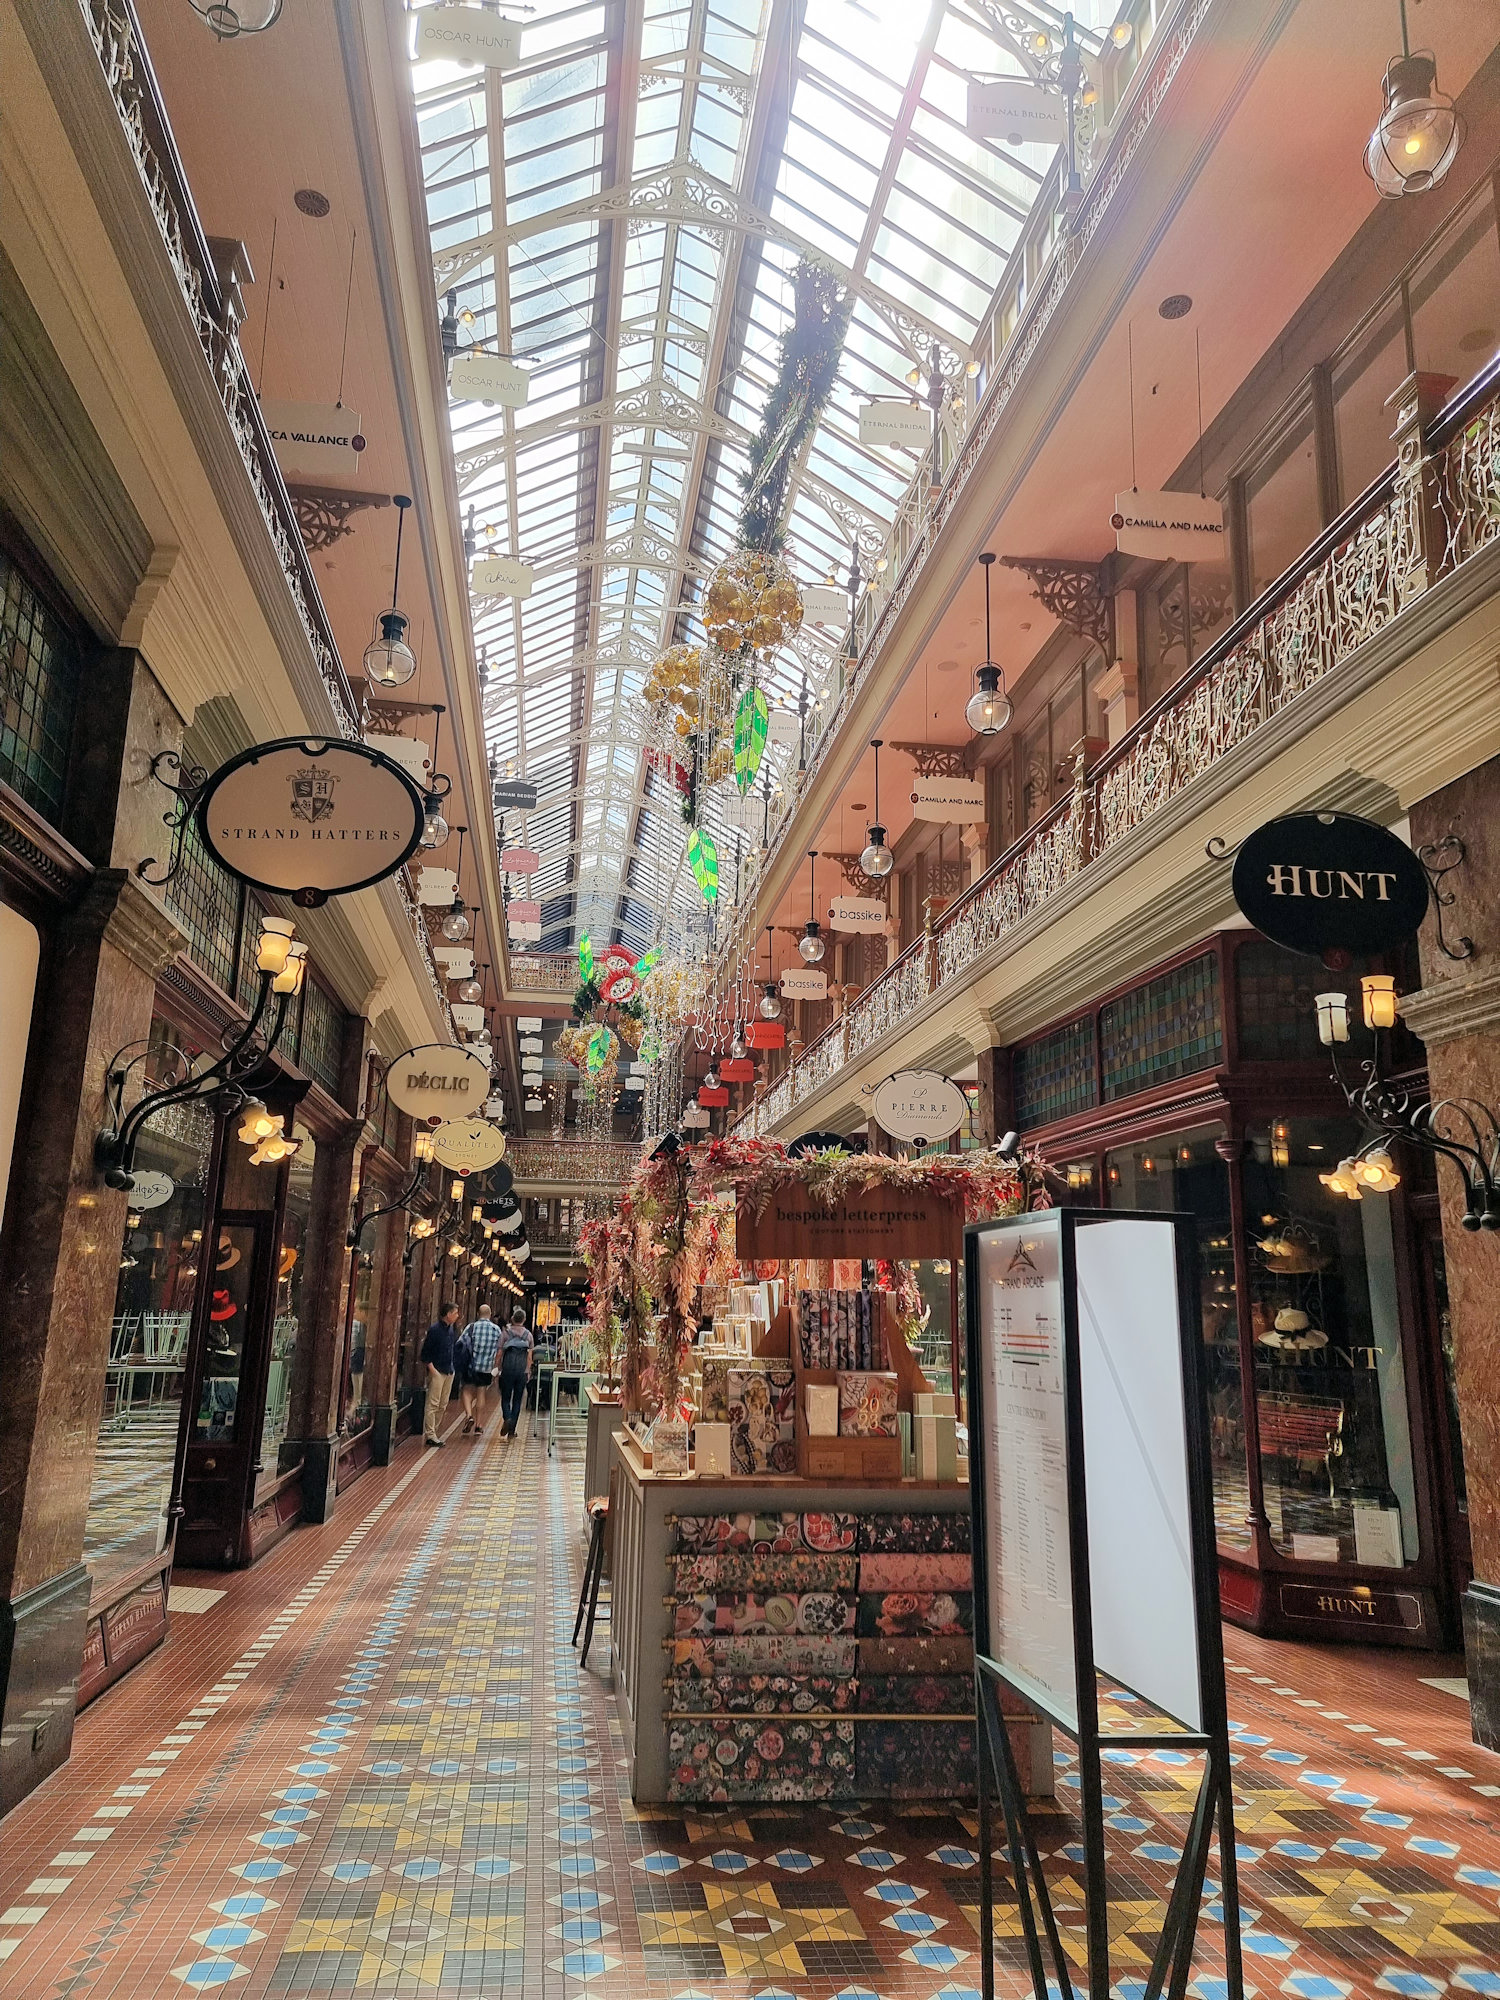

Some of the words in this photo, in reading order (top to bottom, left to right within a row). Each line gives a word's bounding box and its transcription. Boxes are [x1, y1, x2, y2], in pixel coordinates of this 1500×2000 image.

[424, 27, 471, 44] OSCAR
[476, 35, 512, 48] HUNT
[973, 105, 1019, 117] ETERNAL
[1021, 110, 1058, 121] BRIDAL
[458, 374, 493, 388] OSCAR
[495, 381, 522, 392] HUNT
[863, 420, 898, 429] ETERNAL
[899, 423, 927, 431] BRIDAL
[290, 432, 349, 446] VALLANCE
[1125, 518, 1167, 529] CAMILLA
[1169, 521, 1191, 531] AND
[1193, 523, 1223, 533] MARC
[919, 796, 948, 804] CAMILLA
[221, 828, 300, 840] STRAND
[311, 829, 401, 841] HATTERS
[1266, 864, 1397, 901] HUNT
[304, 889, 315, 905] 8
[839, 908, 882, 922] bassike
[788, 978, 824, 990] bassike
[407, 1070, 470, 1092] DÉCLIC
[891, 1102, 949, 1112] PIERRE
[895, 1110, 944, 1120] Diamonds
[776, 1207, 838, 1224] bespoke
[843, 1207, 927, 1224] letterpress
[1276, 1341, 1383, 1370] HUNT
[1317, 1595, 1377, 1616] HUNT
